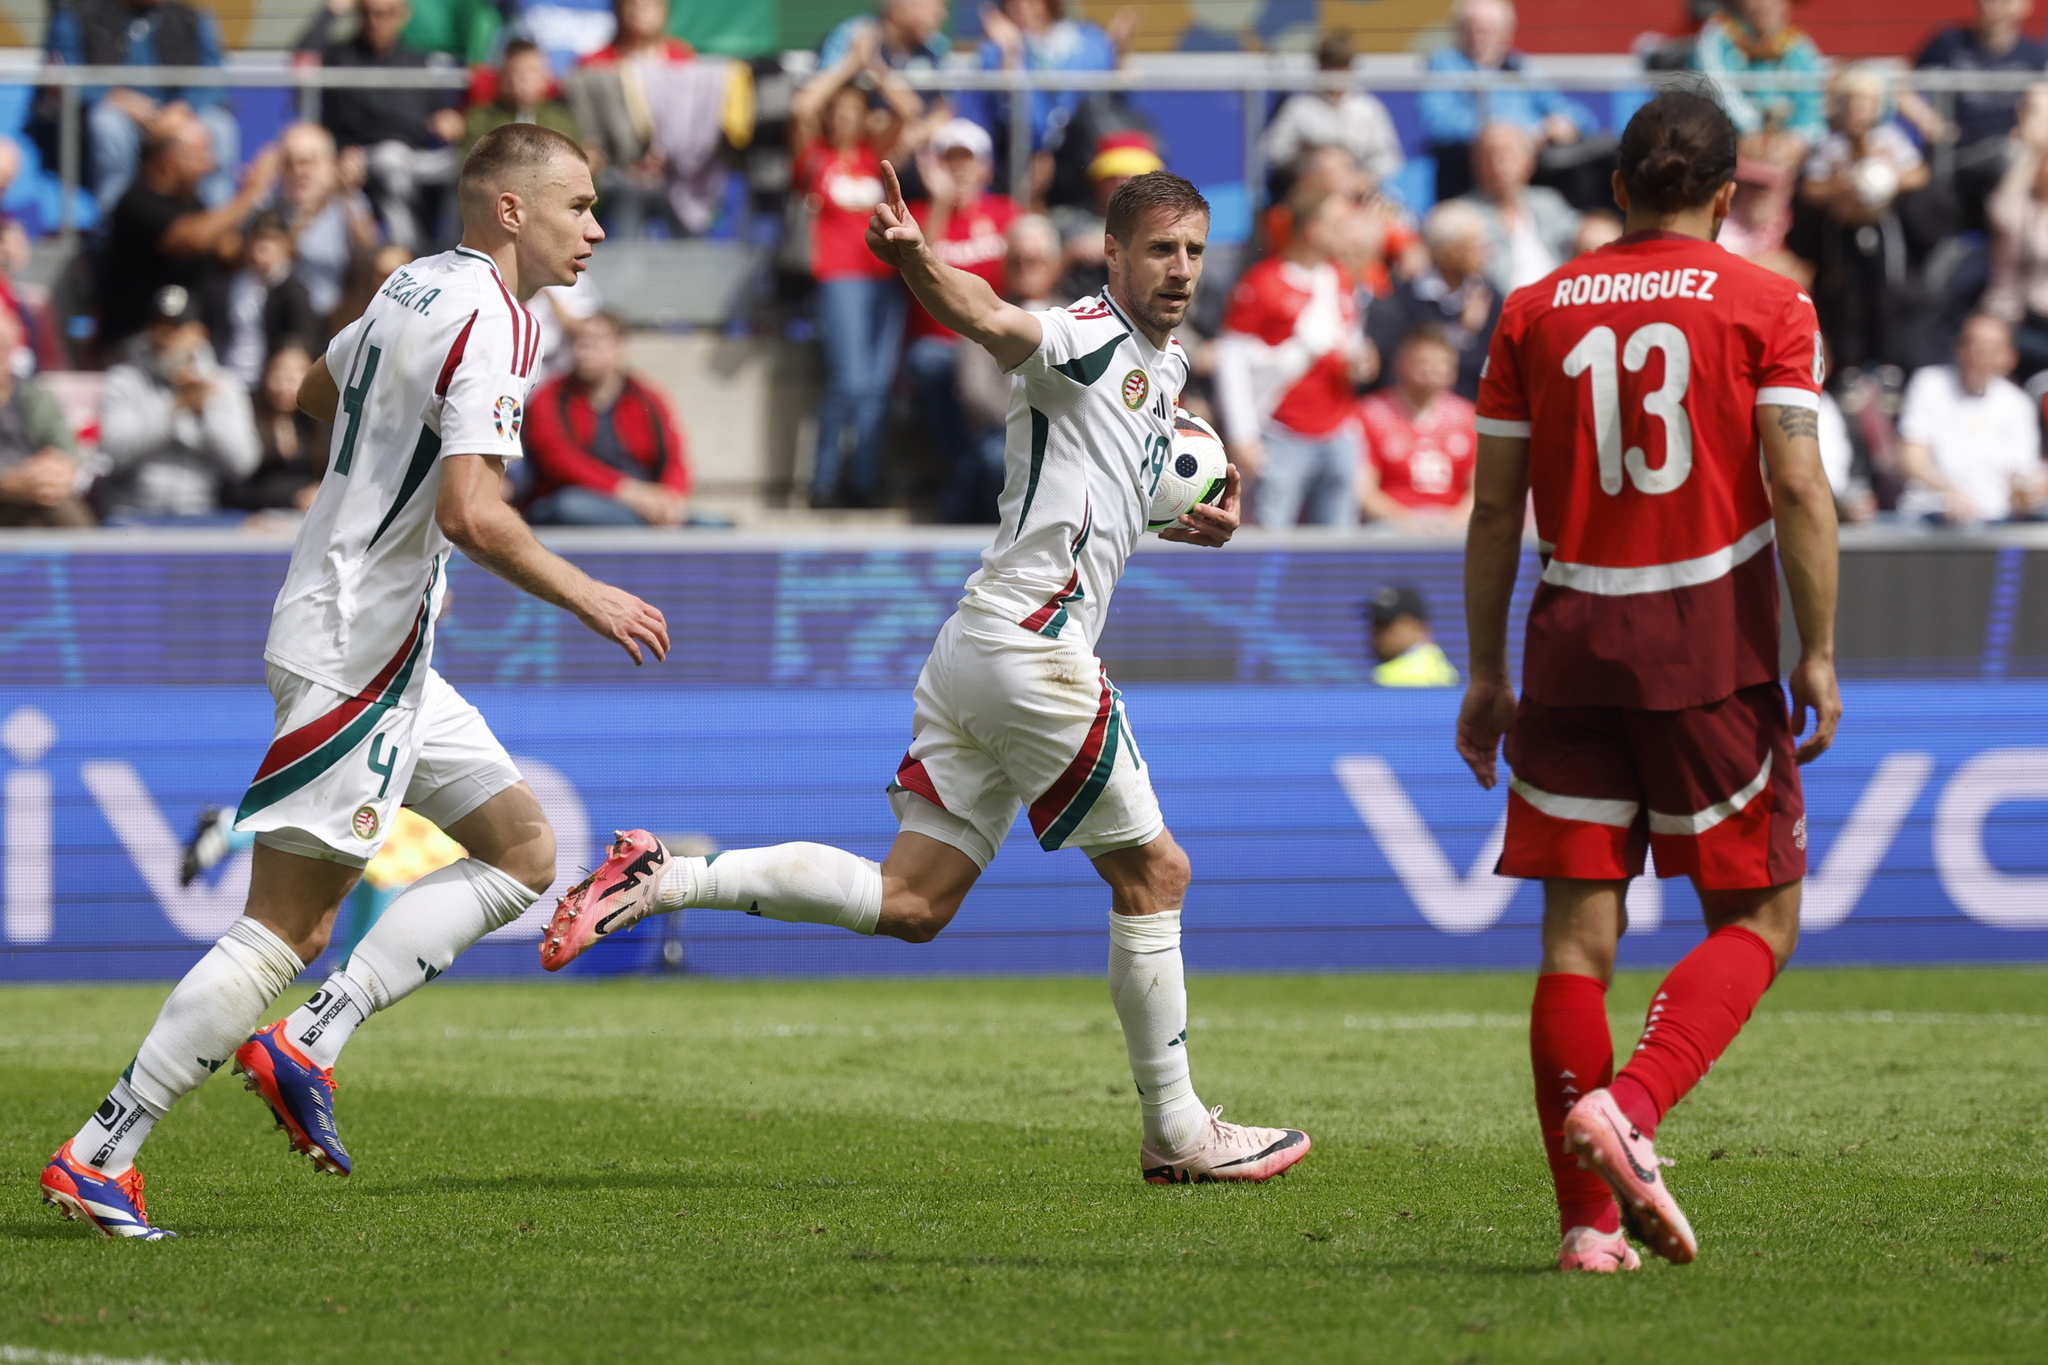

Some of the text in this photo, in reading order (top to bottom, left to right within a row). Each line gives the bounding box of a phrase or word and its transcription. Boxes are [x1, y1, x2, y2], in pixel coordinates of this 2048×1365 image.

[413, 288, 442, 316] A.
[1552, 268, 1718, 308] RODRIGUEZ
[333, 318, 382, 477] 4
[1562, 322, 1693, 496] 13
[1139, 432, 1170, 498] 19
[367, 732, 398, 799] 4
